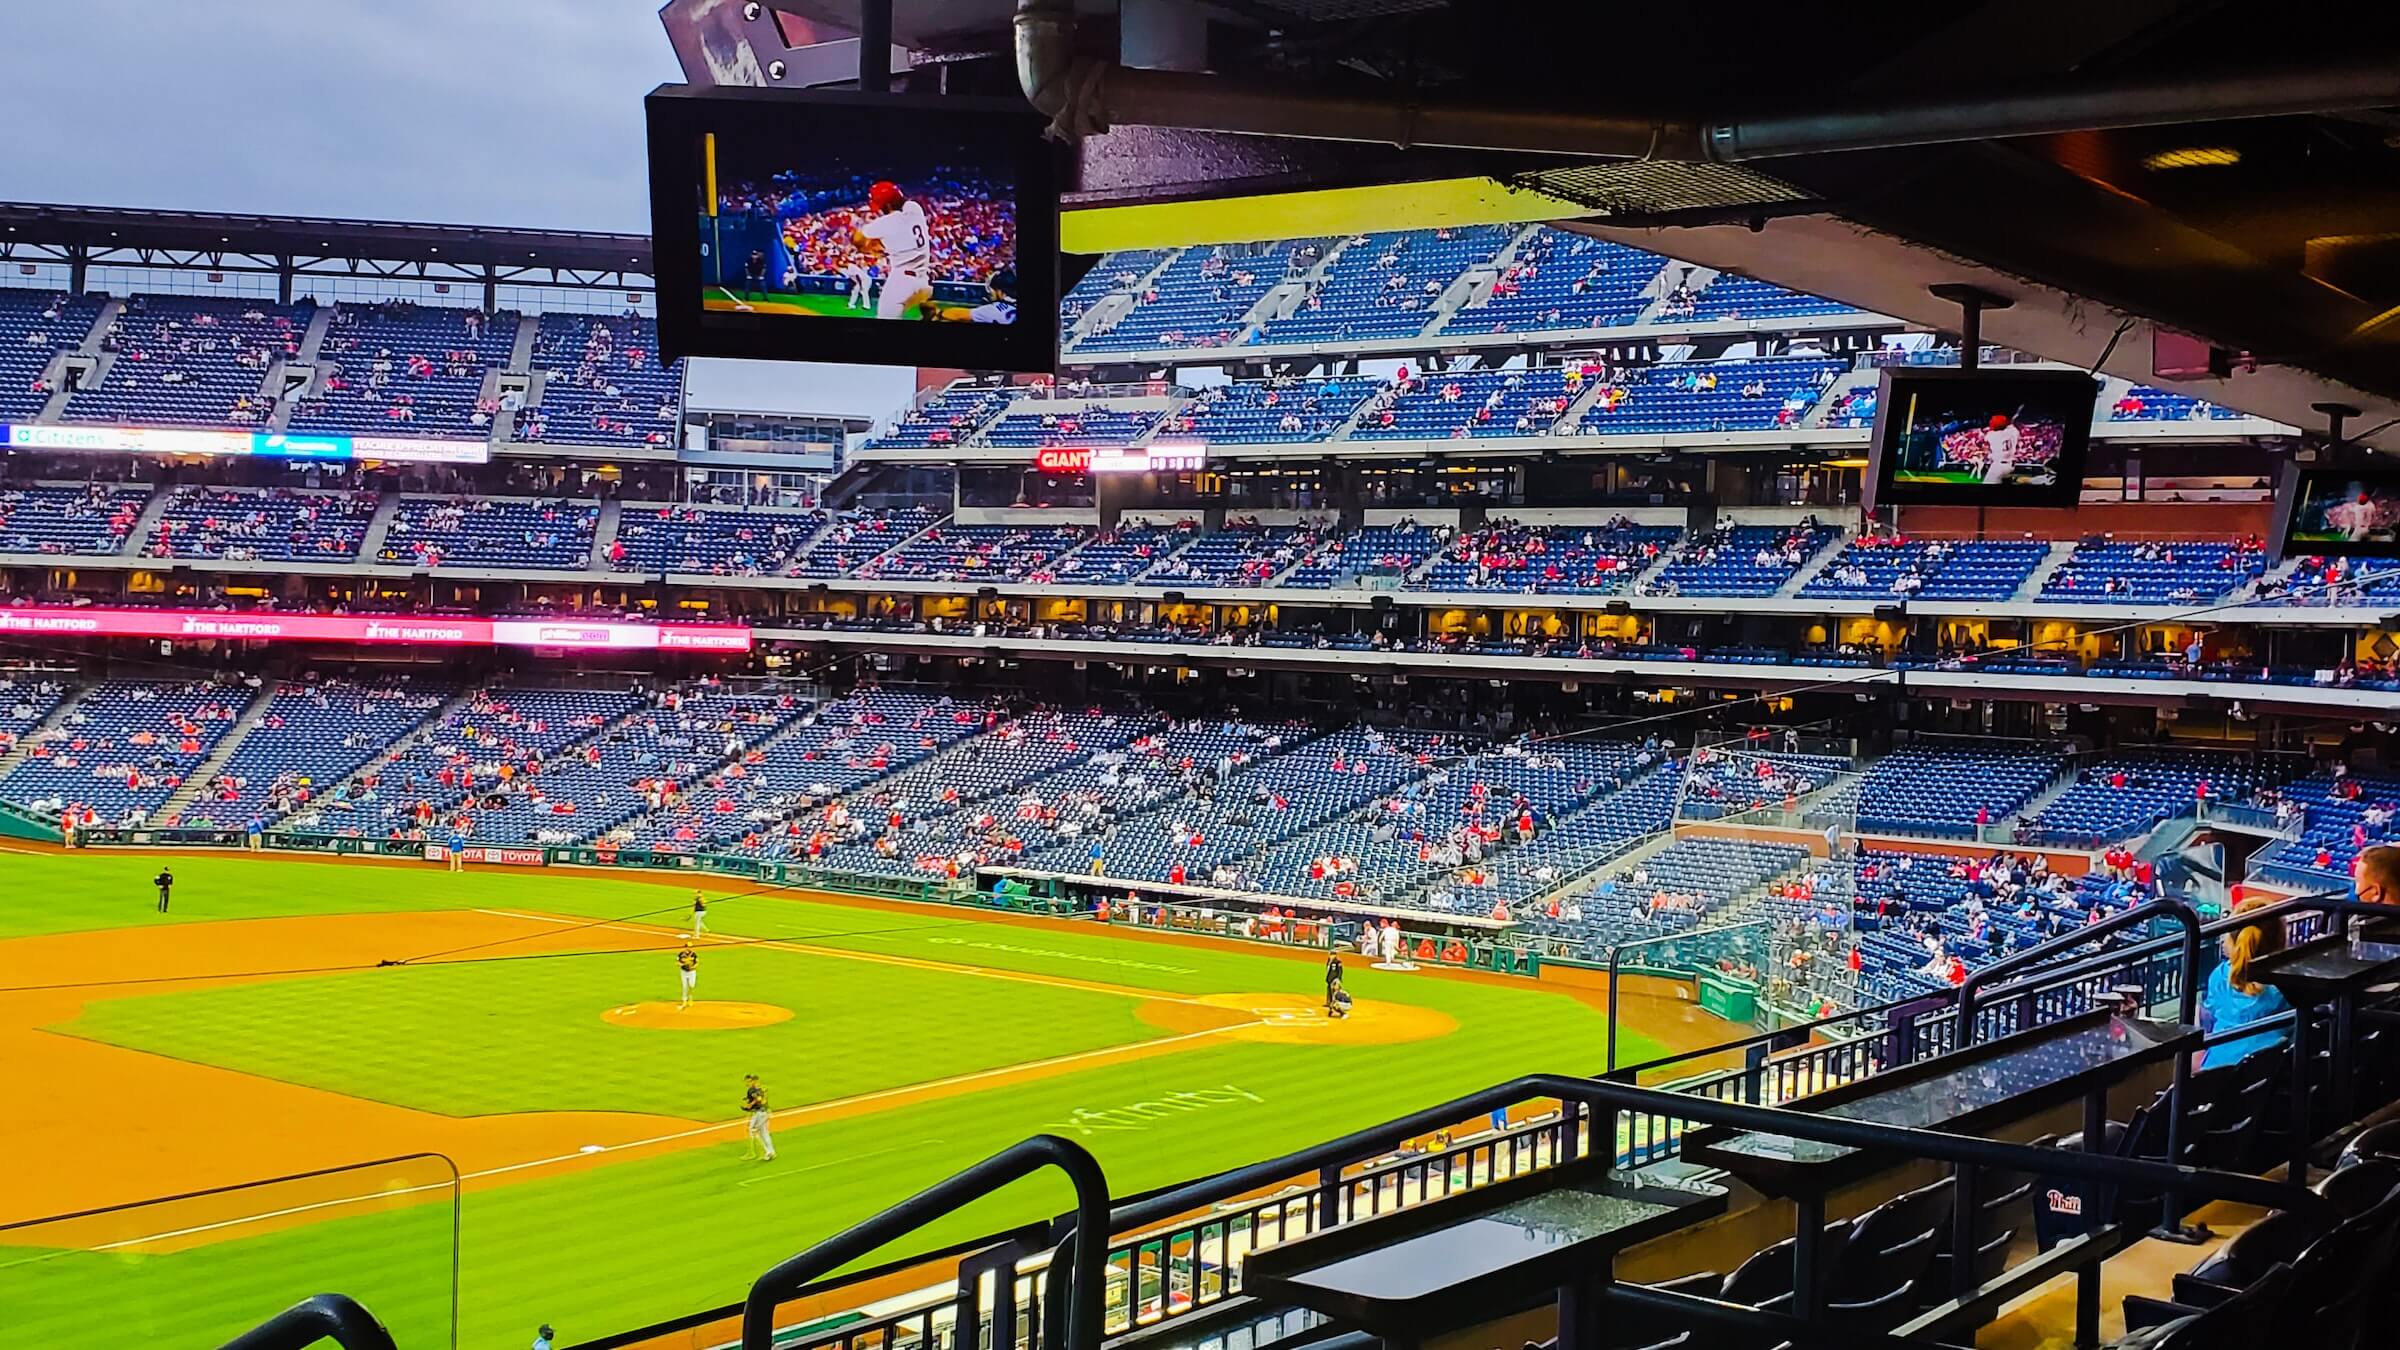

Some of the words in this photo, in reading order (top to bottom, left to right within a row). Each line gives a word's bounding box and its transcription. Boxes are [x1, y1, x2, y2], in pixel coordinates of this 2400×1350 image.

[912, 225, 925, 248] 3
[36, 430, 104, 448] Citizens
[1041, 452, 1091, 468] GIANT
[9, 617, 33, 629] THE
[34, 618, 97, 631] HARTFORD
[194, 622, 217, 634] THE
[219, 624, 281, 636] HARTFORD
[377, 628, 399, 638] THE
[401, 628, 463, 641] HARTFORD
[671, 636, 690, 646] THE
[693, 637, 747, 648] HARTFORD
[444, 848, 483, 859] TOTA
[503, 851, 543, 862] TOYOTA
[1042, 1084, 1265, 1134] xfinity
